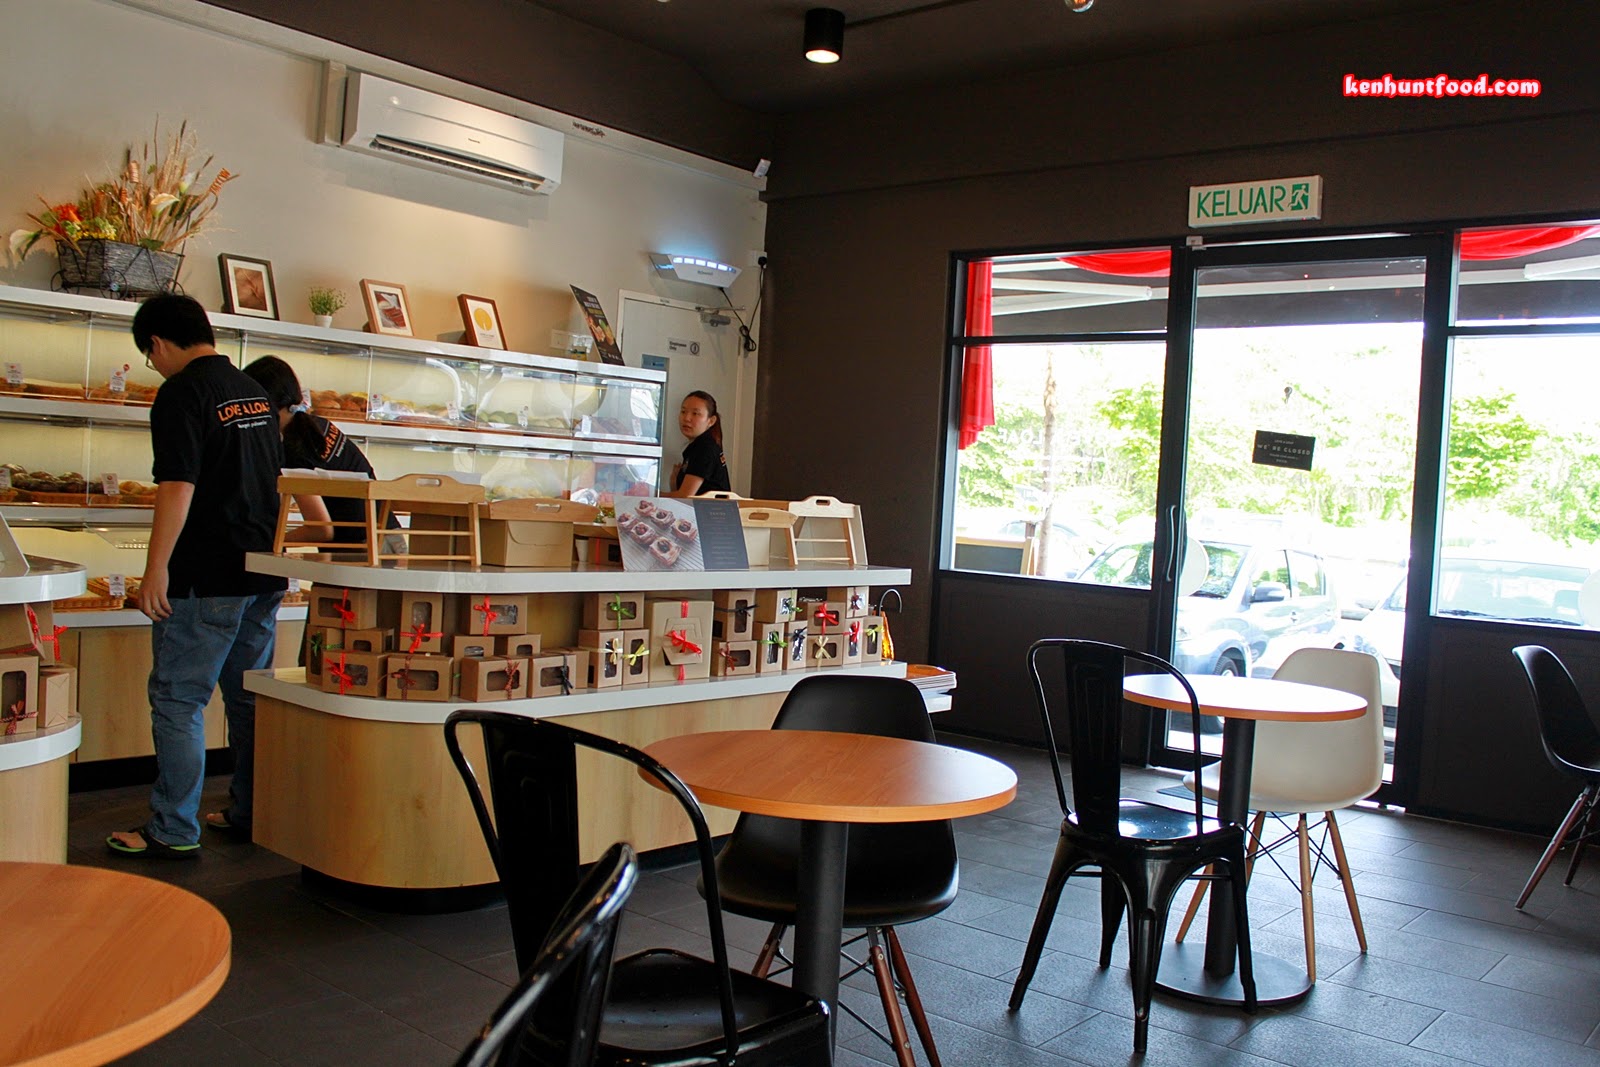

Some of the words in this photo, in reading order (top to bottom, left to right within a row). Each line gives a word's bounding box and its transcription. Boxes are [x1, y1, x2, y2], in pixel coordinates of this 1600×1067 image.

[1197, 186, 1286, 218] KELUAR
[217, 404, 243, 422] LOVE
[1283, 447, 1311, 456] CLOSED
